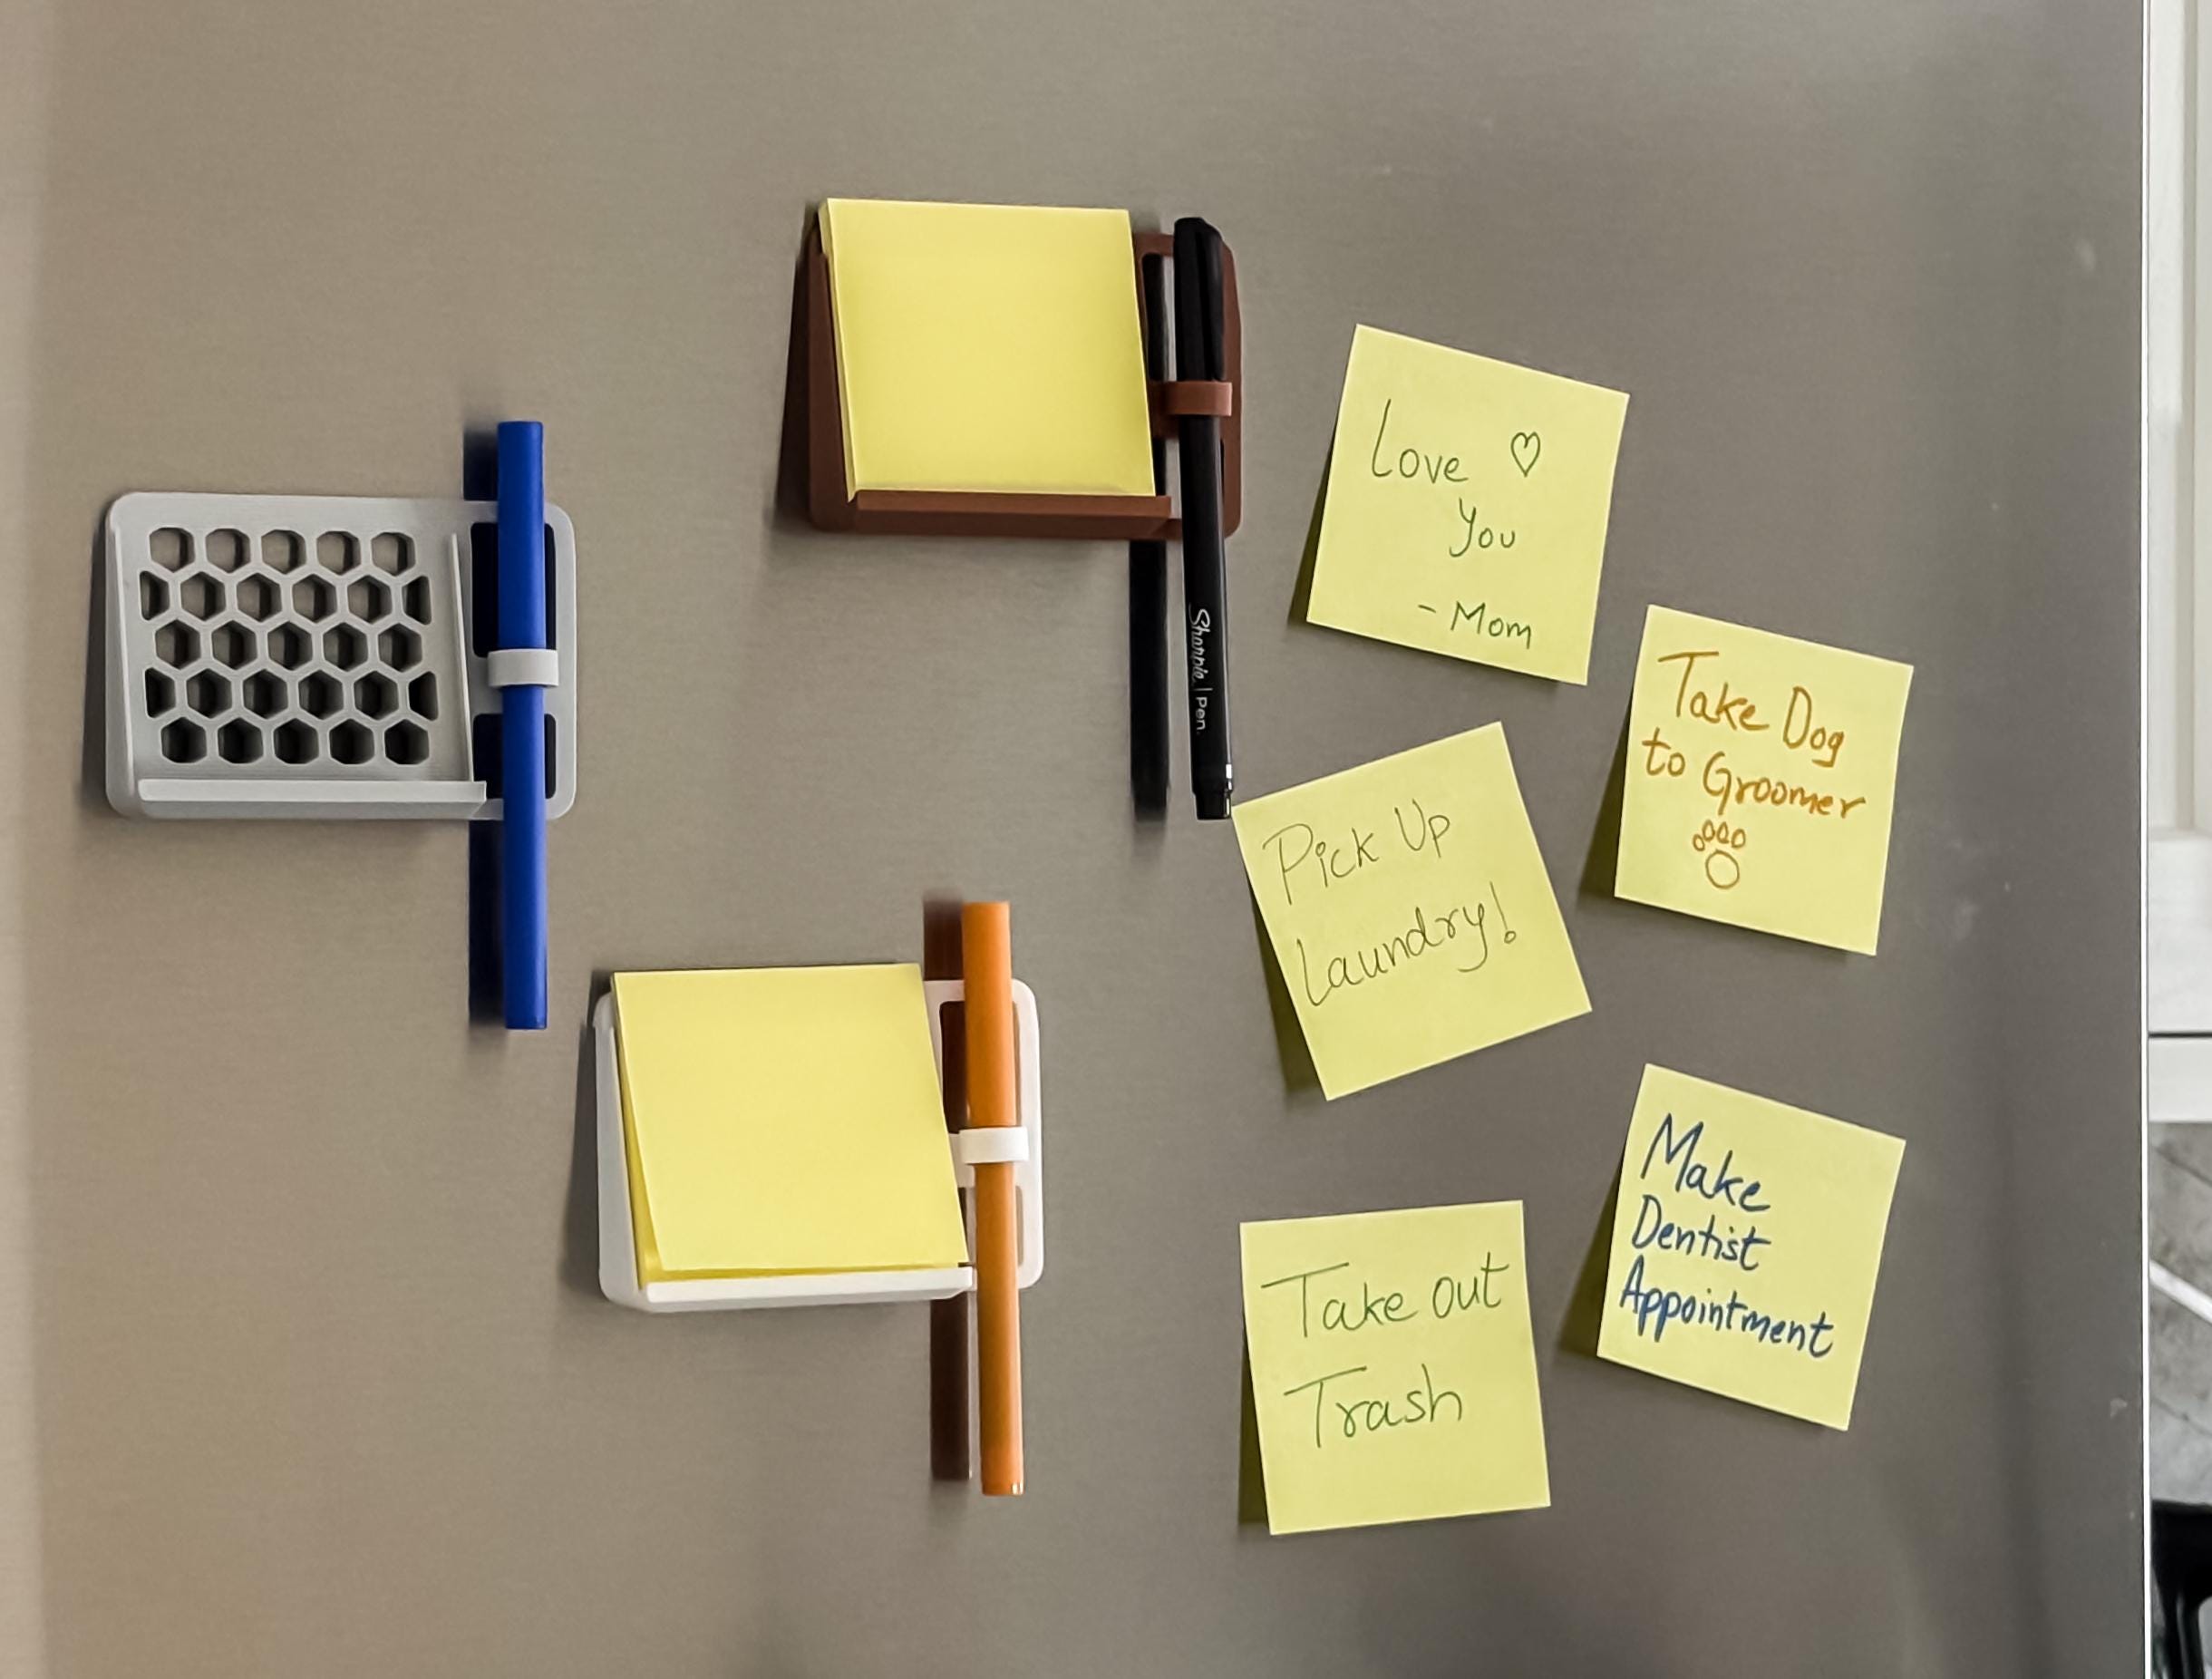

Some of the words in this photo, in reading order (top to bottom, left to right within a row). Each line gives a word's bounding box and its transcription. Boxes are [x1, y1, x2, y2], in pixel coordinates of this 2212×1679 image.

[1371, 399, 1470, 485] Love
[1188, 604, 1212, 685] Sharpie
[1657, 650, 1771, 731] Take
[1783, 685, 1845, 769] Dog
[1641, 726, 1686, 778] to
[1703, 752, 1868, 820] Groomer
[1262, 823, 1381, 906] Pick
[1393, 799, 1451, 859] Up
[1640, 1111, 1771, 1213] Make
[1631, 1195, 1772, 1271] Dentist
[1260, 1261, 1419, 1338] Take
[1431, 1252, 1511, 1319] out
[1618, 1255, 1835, 1359] Appointment
[1283, 1363, 1463, 1449] Trash
